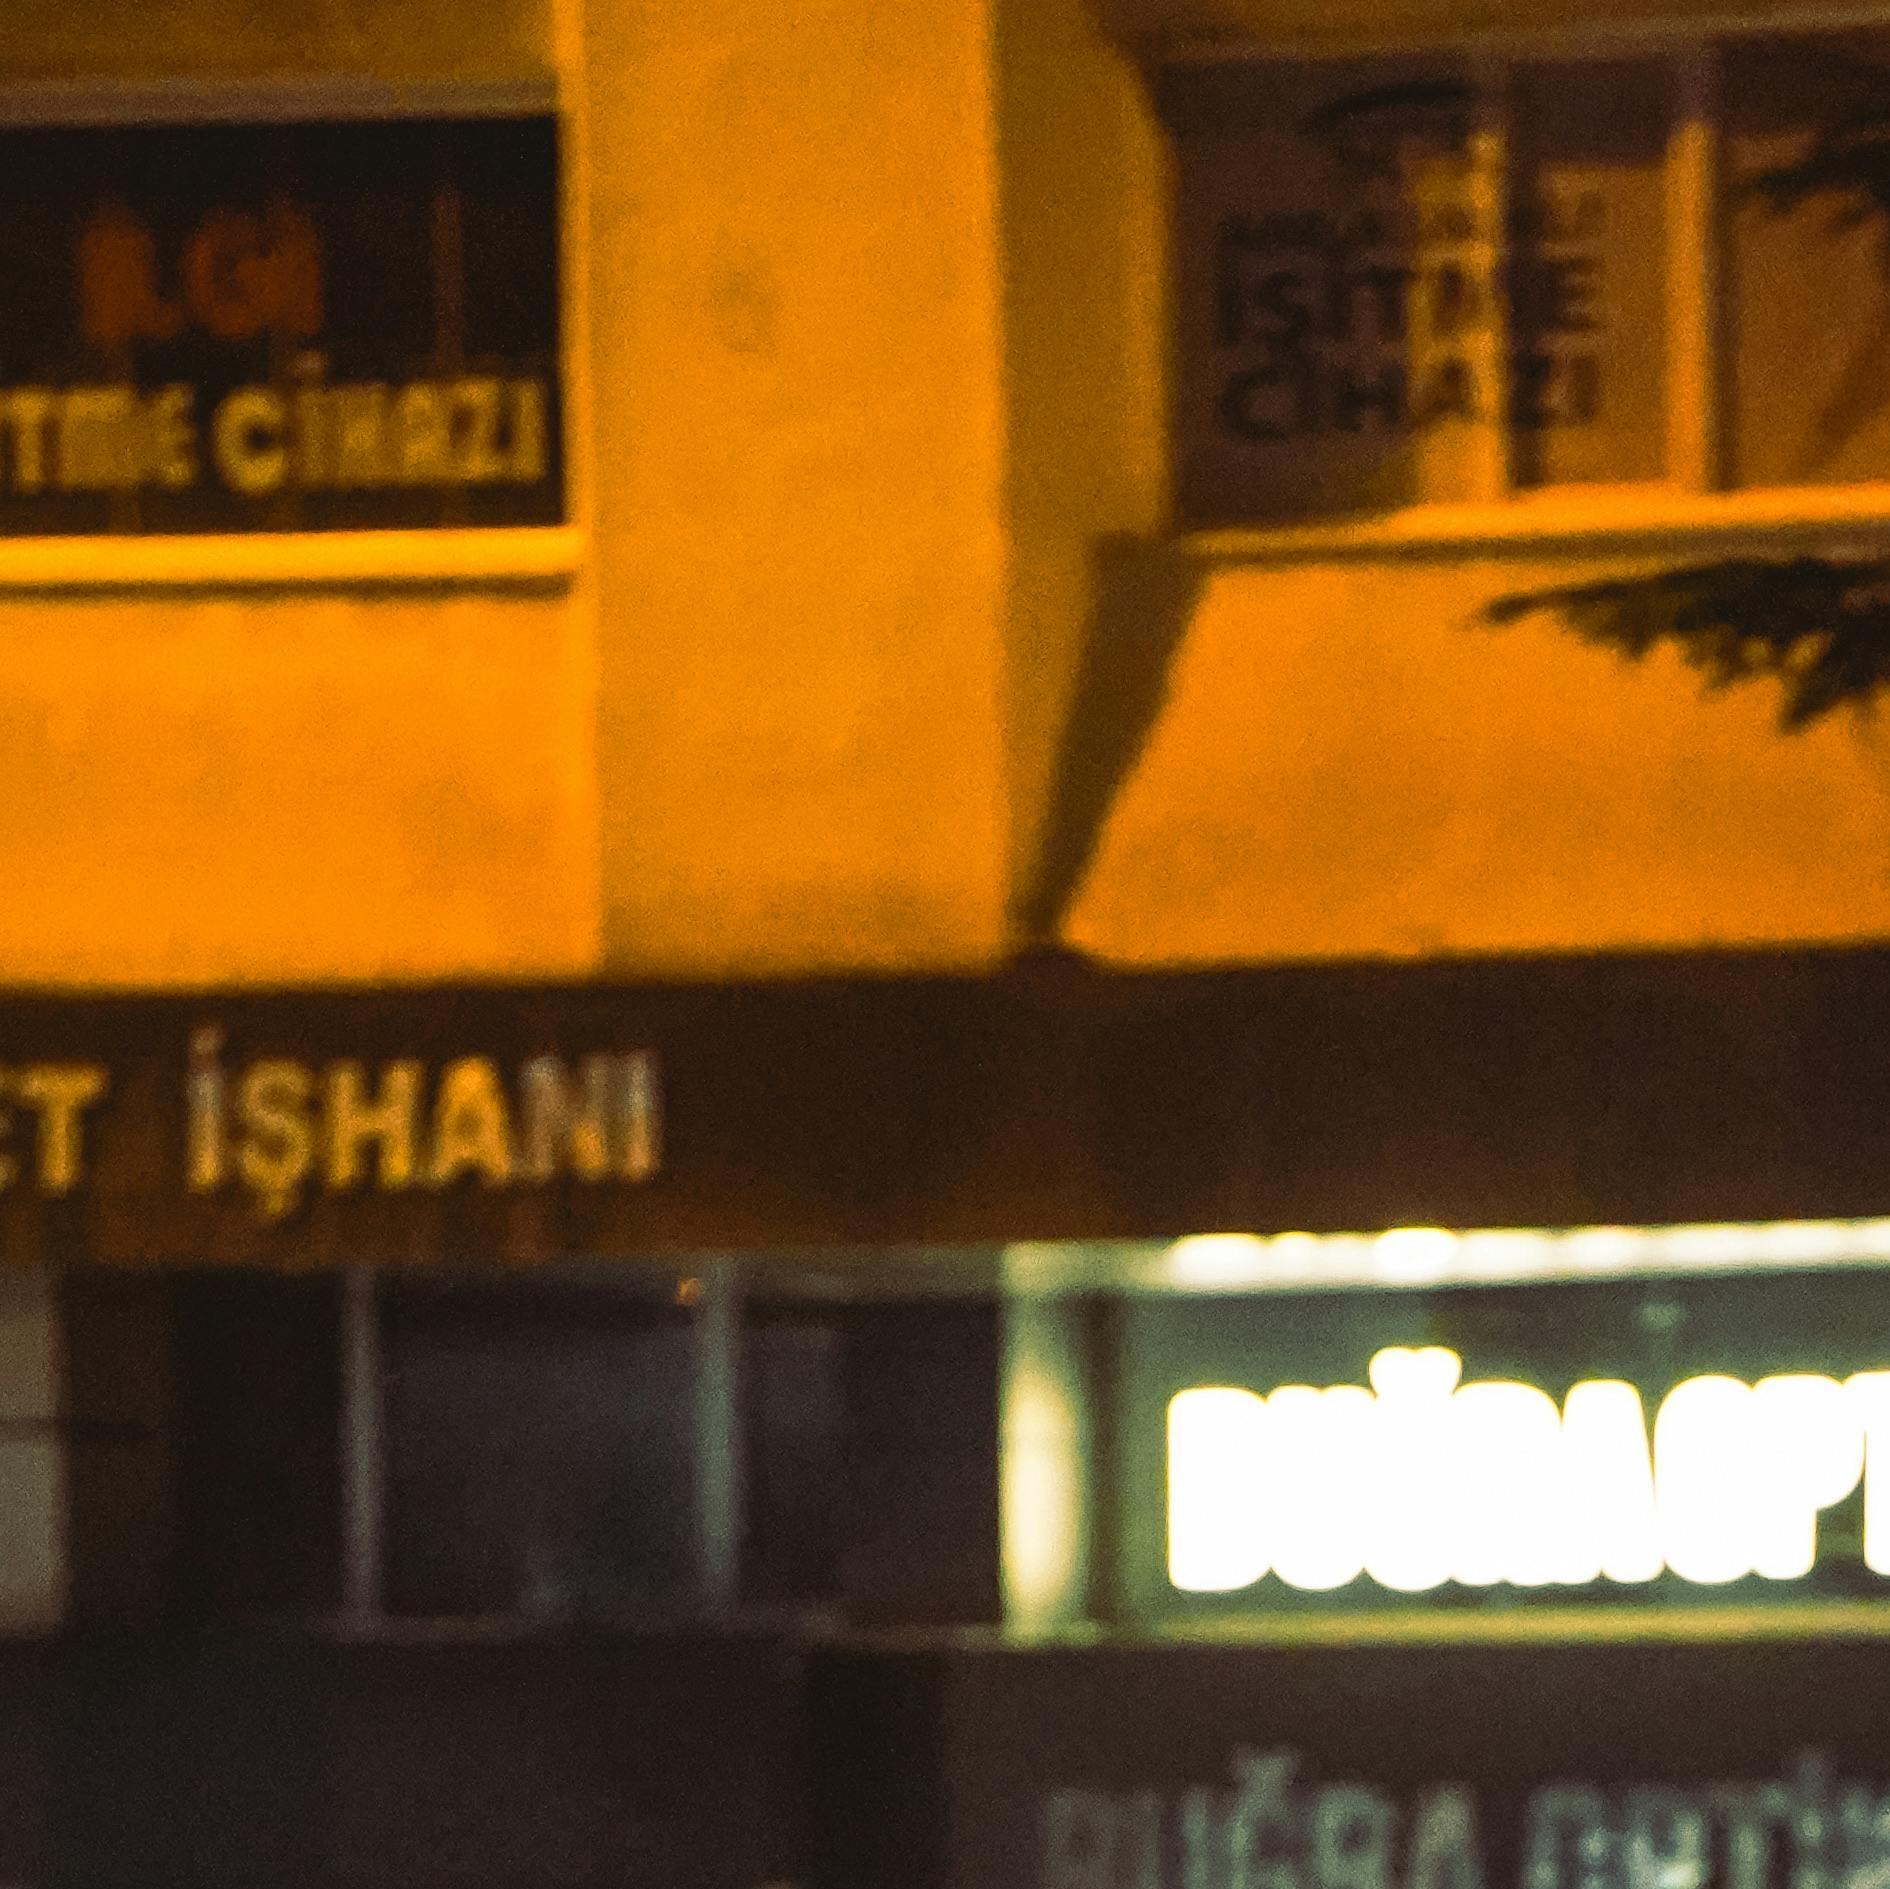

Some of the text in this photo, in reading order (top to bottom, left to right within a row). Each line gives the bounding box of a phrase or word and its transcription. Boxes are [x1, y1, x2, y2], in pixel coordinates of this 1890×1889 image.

[0, 1022, 664, 1225] T İŞHANI
[1168, 1346, 1664, 1591] BUĞRA
